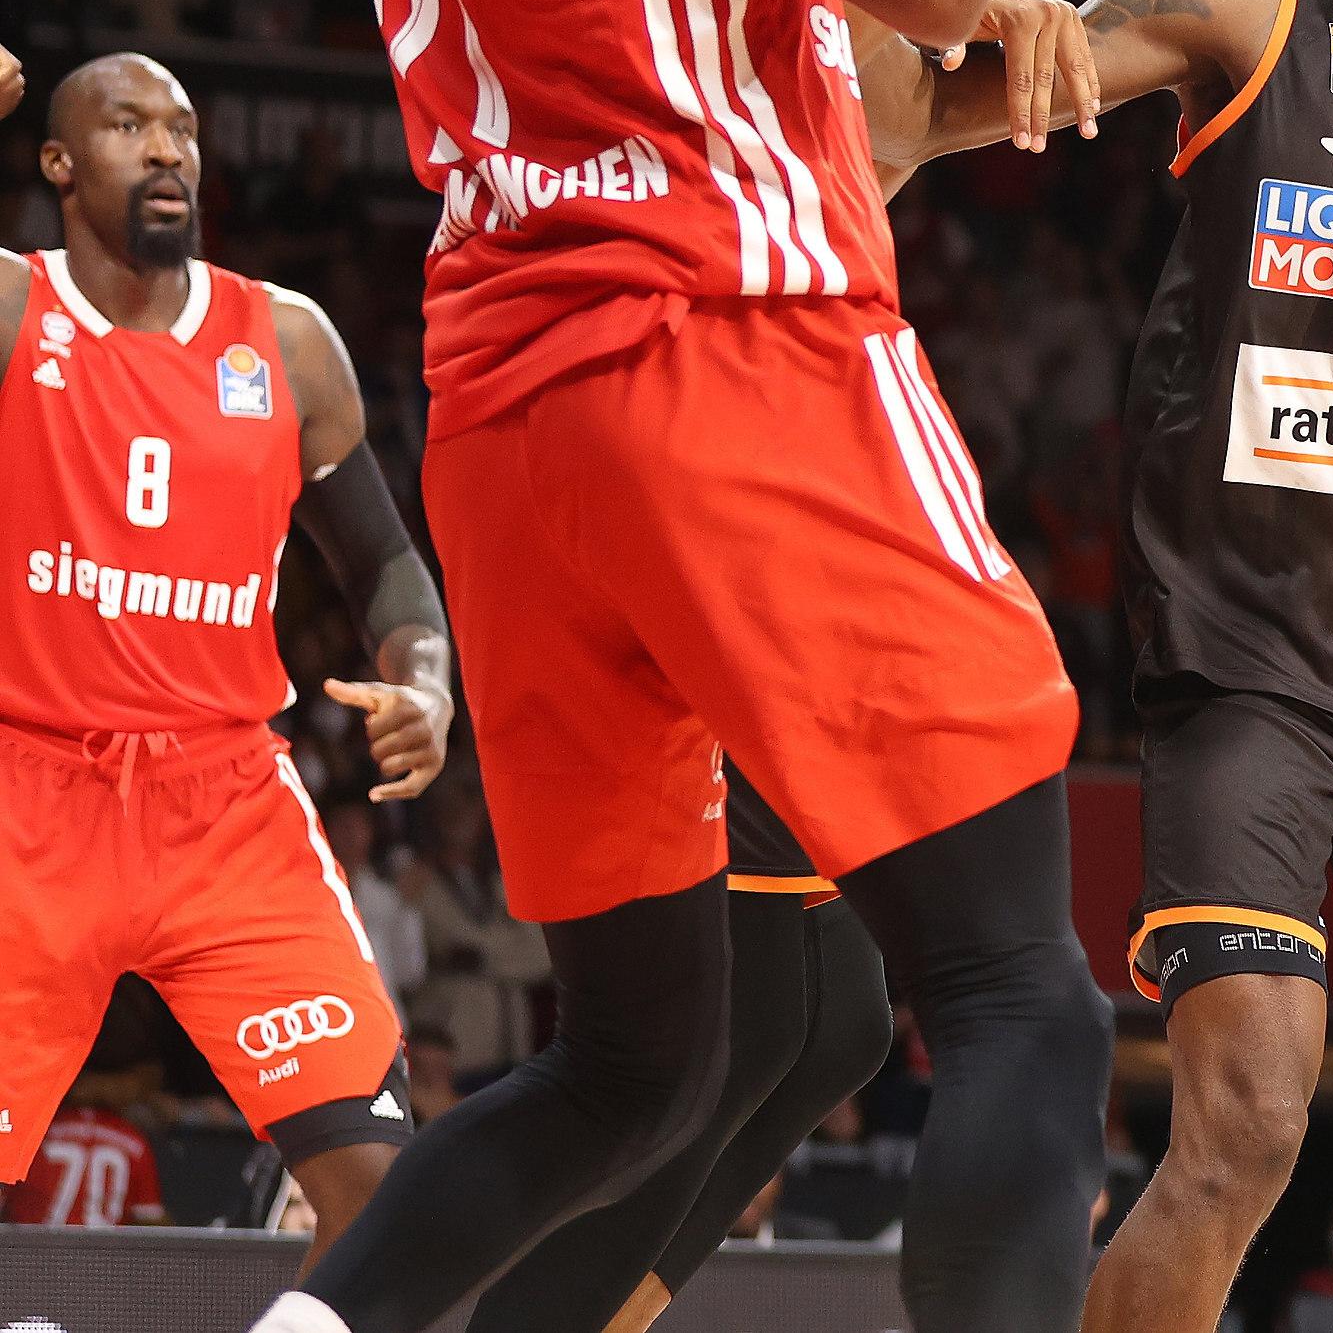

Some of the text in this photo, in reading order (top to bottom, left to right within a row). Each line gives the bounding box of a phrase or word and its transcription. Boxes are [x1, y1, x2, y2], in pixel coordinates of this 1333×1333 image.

[126, 436, 172, 529] 8
[27, 541, 262, 629] siegmund
[258, 1057, 300, 1087] Audi
[43, 1140, 131, 1228] 70
